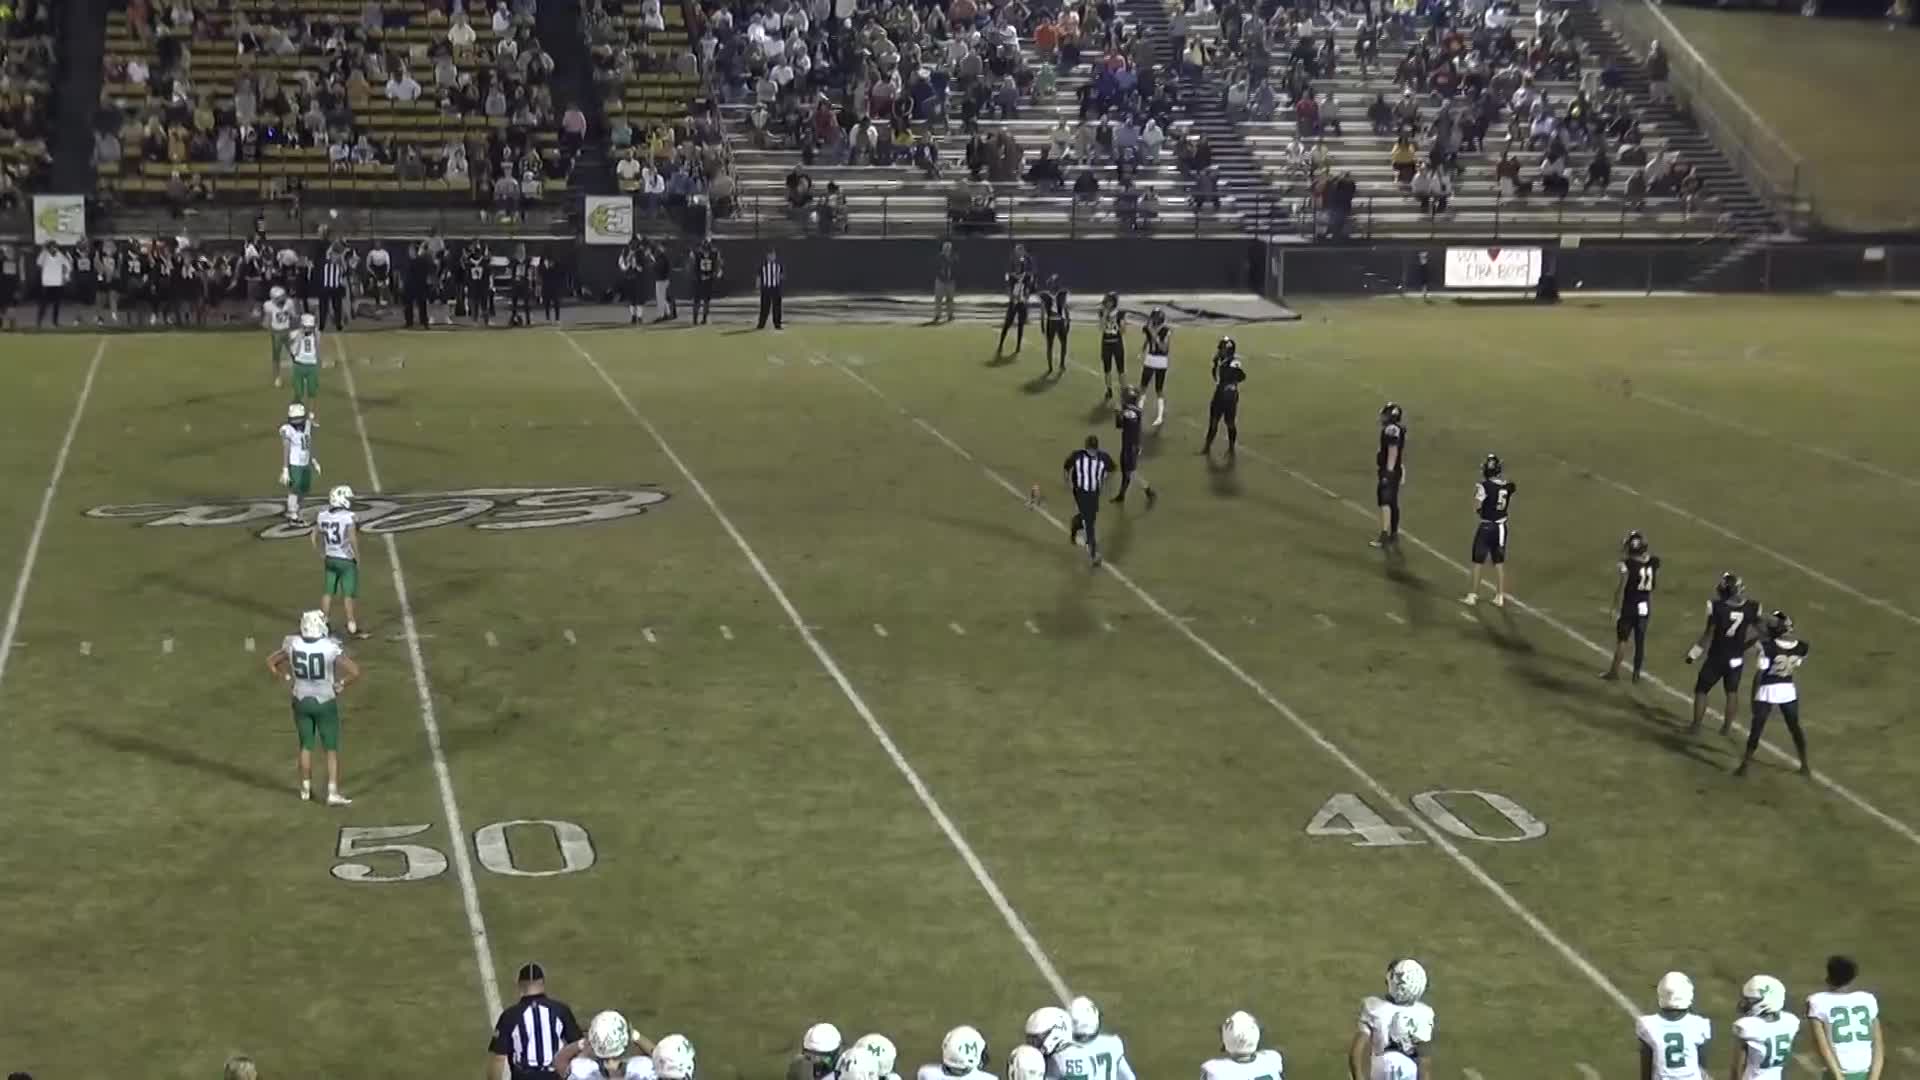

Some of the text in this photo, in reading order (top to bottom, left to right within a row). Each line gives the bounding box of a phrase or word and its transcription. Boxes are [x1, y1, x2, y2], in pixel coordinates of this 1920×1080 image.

[1496, 489, 1508, 511] 5
[1637, 566, 1653, 591] 11
[1726, 611, 1745, 637] 7
[292, 651, 325, 680] 50
[1305, 789, 1548, 847] 40
[330, 819, 597, 882] 50
[1830, 1005, 1873, 1043] 23
[1663, 1032, 1686, 1069] 2
[1759, 1033, 1792, 1069] 15
